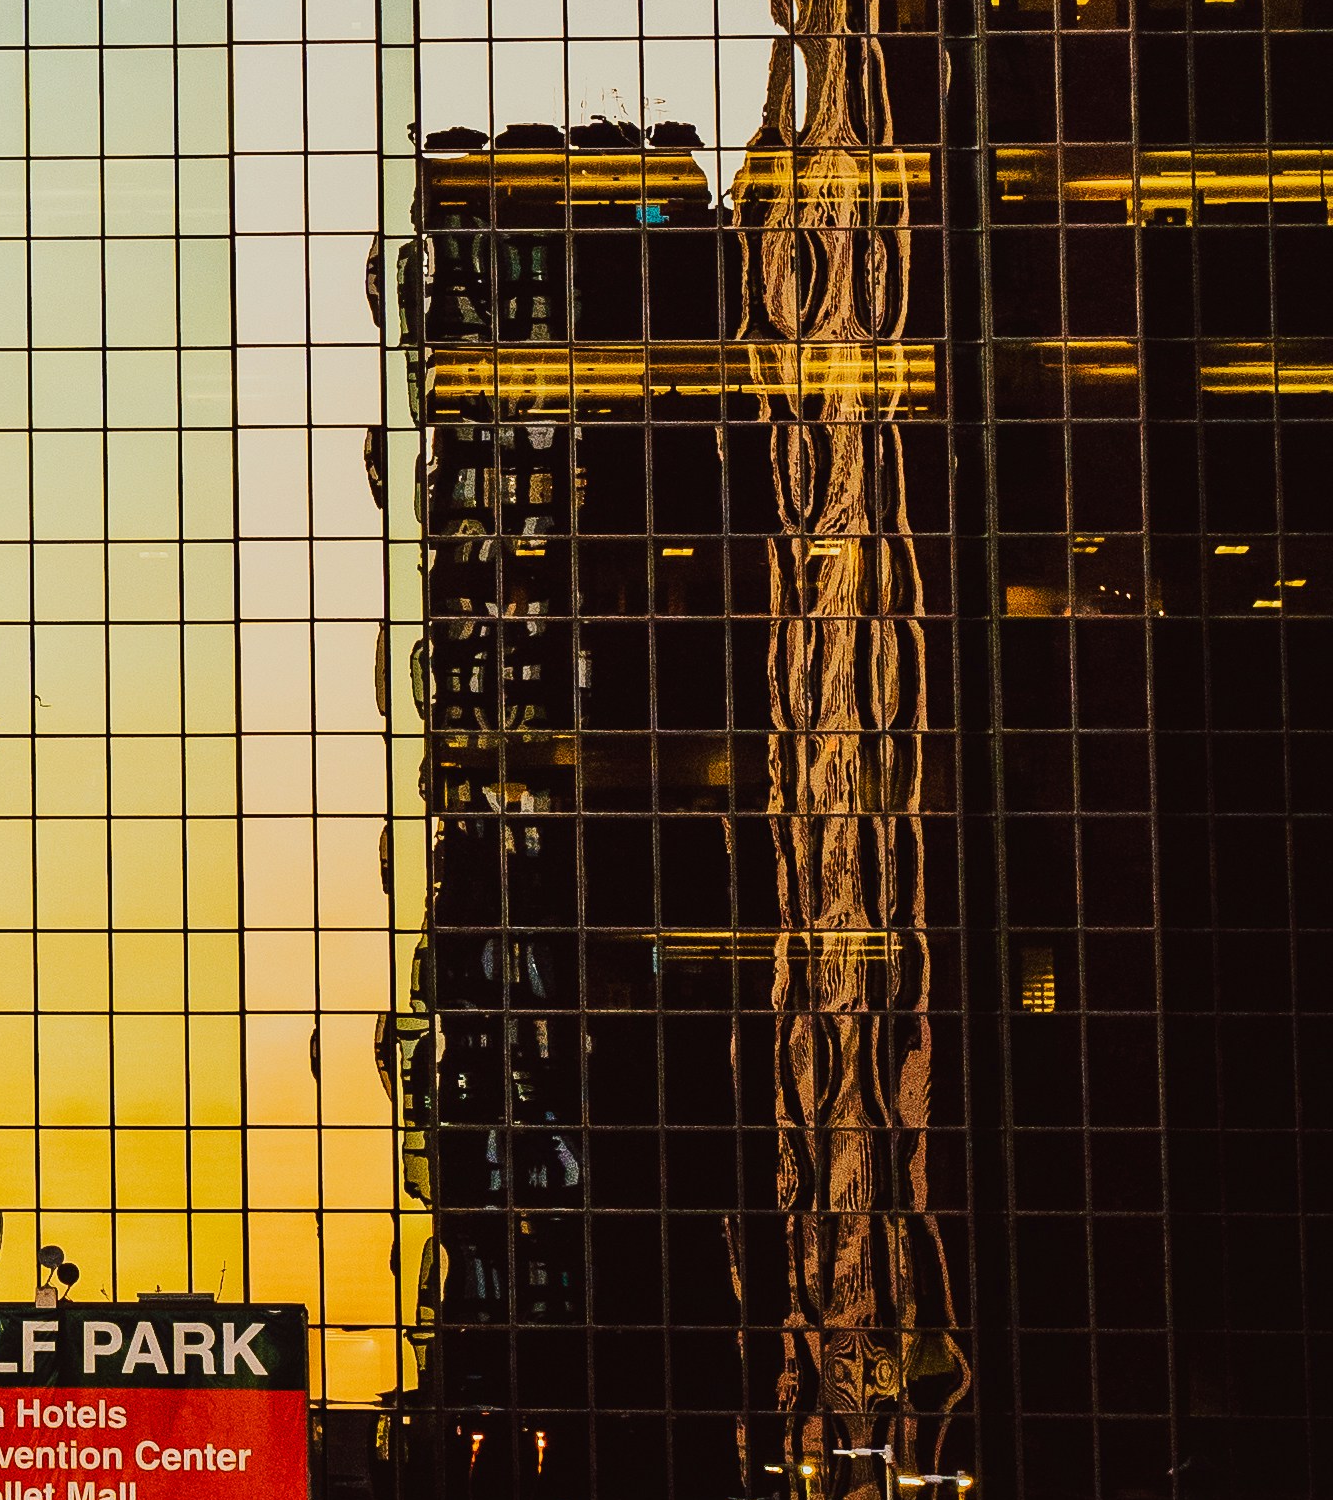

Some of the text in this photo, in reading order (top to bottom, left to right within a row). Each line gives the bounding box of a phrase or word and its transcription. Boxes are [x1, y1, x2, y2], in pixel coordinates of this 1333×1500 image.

[84, 1321, 269, 1376] PARK
[17, 1399, 127, 1429] Hotels
[135, 1440, 252, 1472] Center
